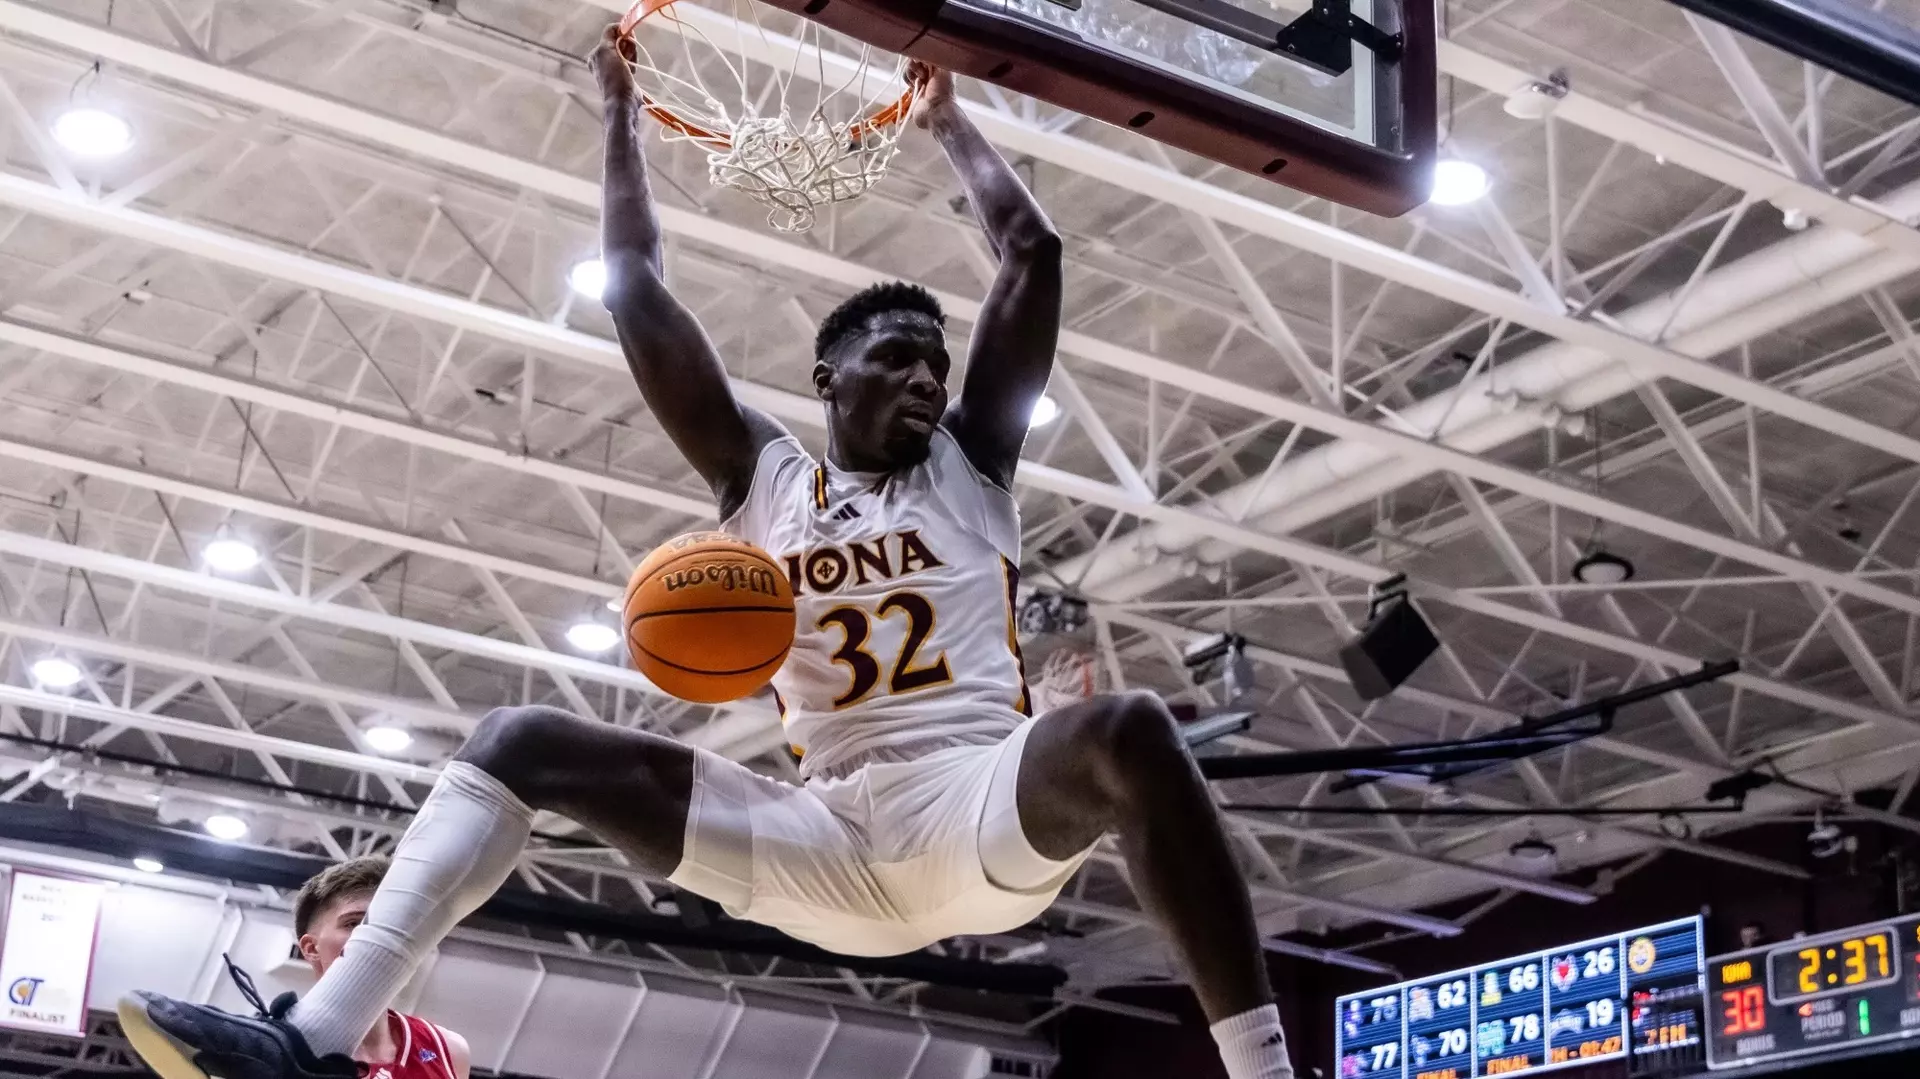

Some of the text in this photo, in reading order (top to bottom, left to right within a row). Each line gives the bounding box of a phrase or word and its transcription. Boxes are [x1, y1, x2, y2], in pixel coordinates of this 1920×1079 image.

[782, 529, 947, 598] IONA
[662, 564, 778, 597] Wilson
[817, 590, 953, 711] 32
[1583, 947, 1615, 978] 26
[1798, 934, 1889, 993] 2:37
[1509, 963, 1539, 993] 66
[1437, 979, 1466, 1009] 62
[9, 1007, 66, 1024] FINALIST
[1586, 998, 1614, 1028] 19
[1722, 985, 1766, 1036] 30
[1801, 1009, 1846, 1033] PERIOD
[1859, 999, 1870, 1035] 1
[1438, 1028, 1467, 1057] 70
[1510, 1013, 1540, 1043] 78
[1371, 1042, 1398, 1070] 77
[1487, 1054, 1532, 1075] FINAL
